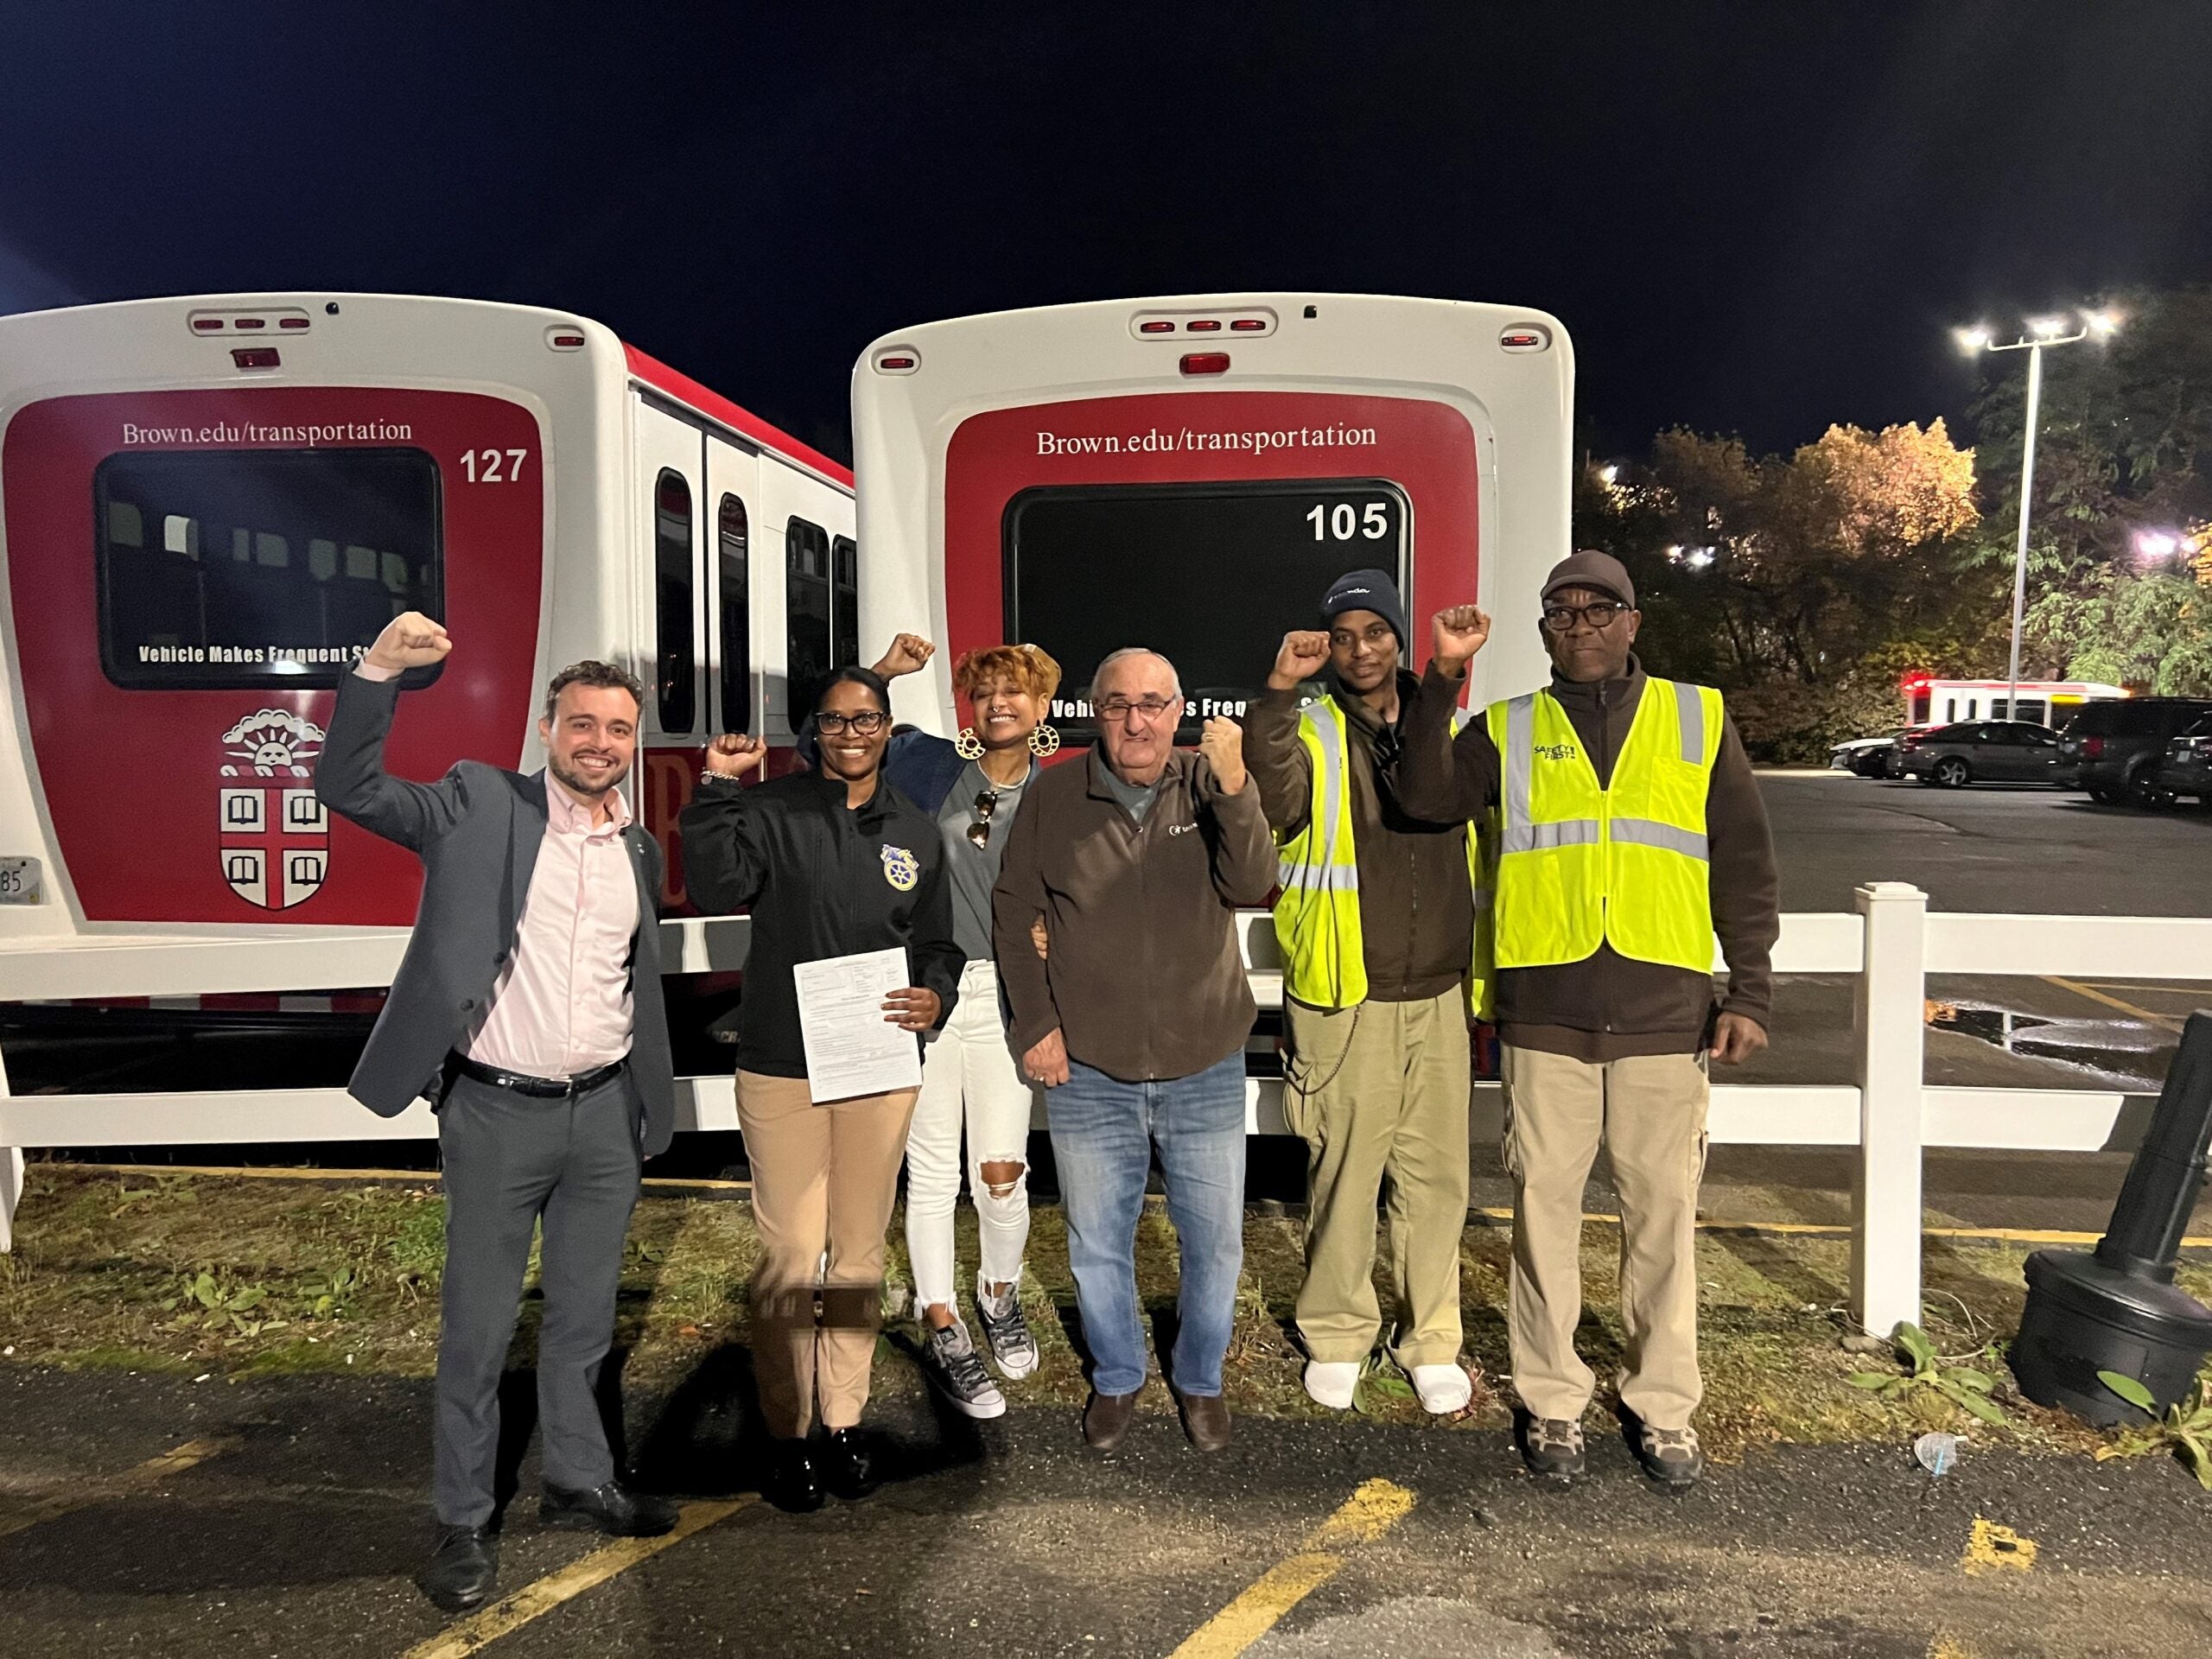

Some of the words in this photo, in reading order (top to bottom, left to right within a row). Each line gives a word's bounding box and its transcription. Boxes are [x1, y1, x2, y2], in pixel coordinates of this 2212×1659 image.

[123, 418, 412, 447] Brown.edu/transportation
[1037, 422, 1376, 455] Brown.edu/transportation
[460, 448, 527, 483] 127
[1306, 502, 1388, 541] 105
[138, 645, 205, 663] Vehicle
[209, 645, 264, 663] Makes
[268, 645, 348, 664] Frequent
[1051, 699, 1096, 718] Vehi
[1202, 697, 1247, 718] Freq
[1534, 745, 1569, 754] SAFETY
[1, 870, 22, 892] 85
